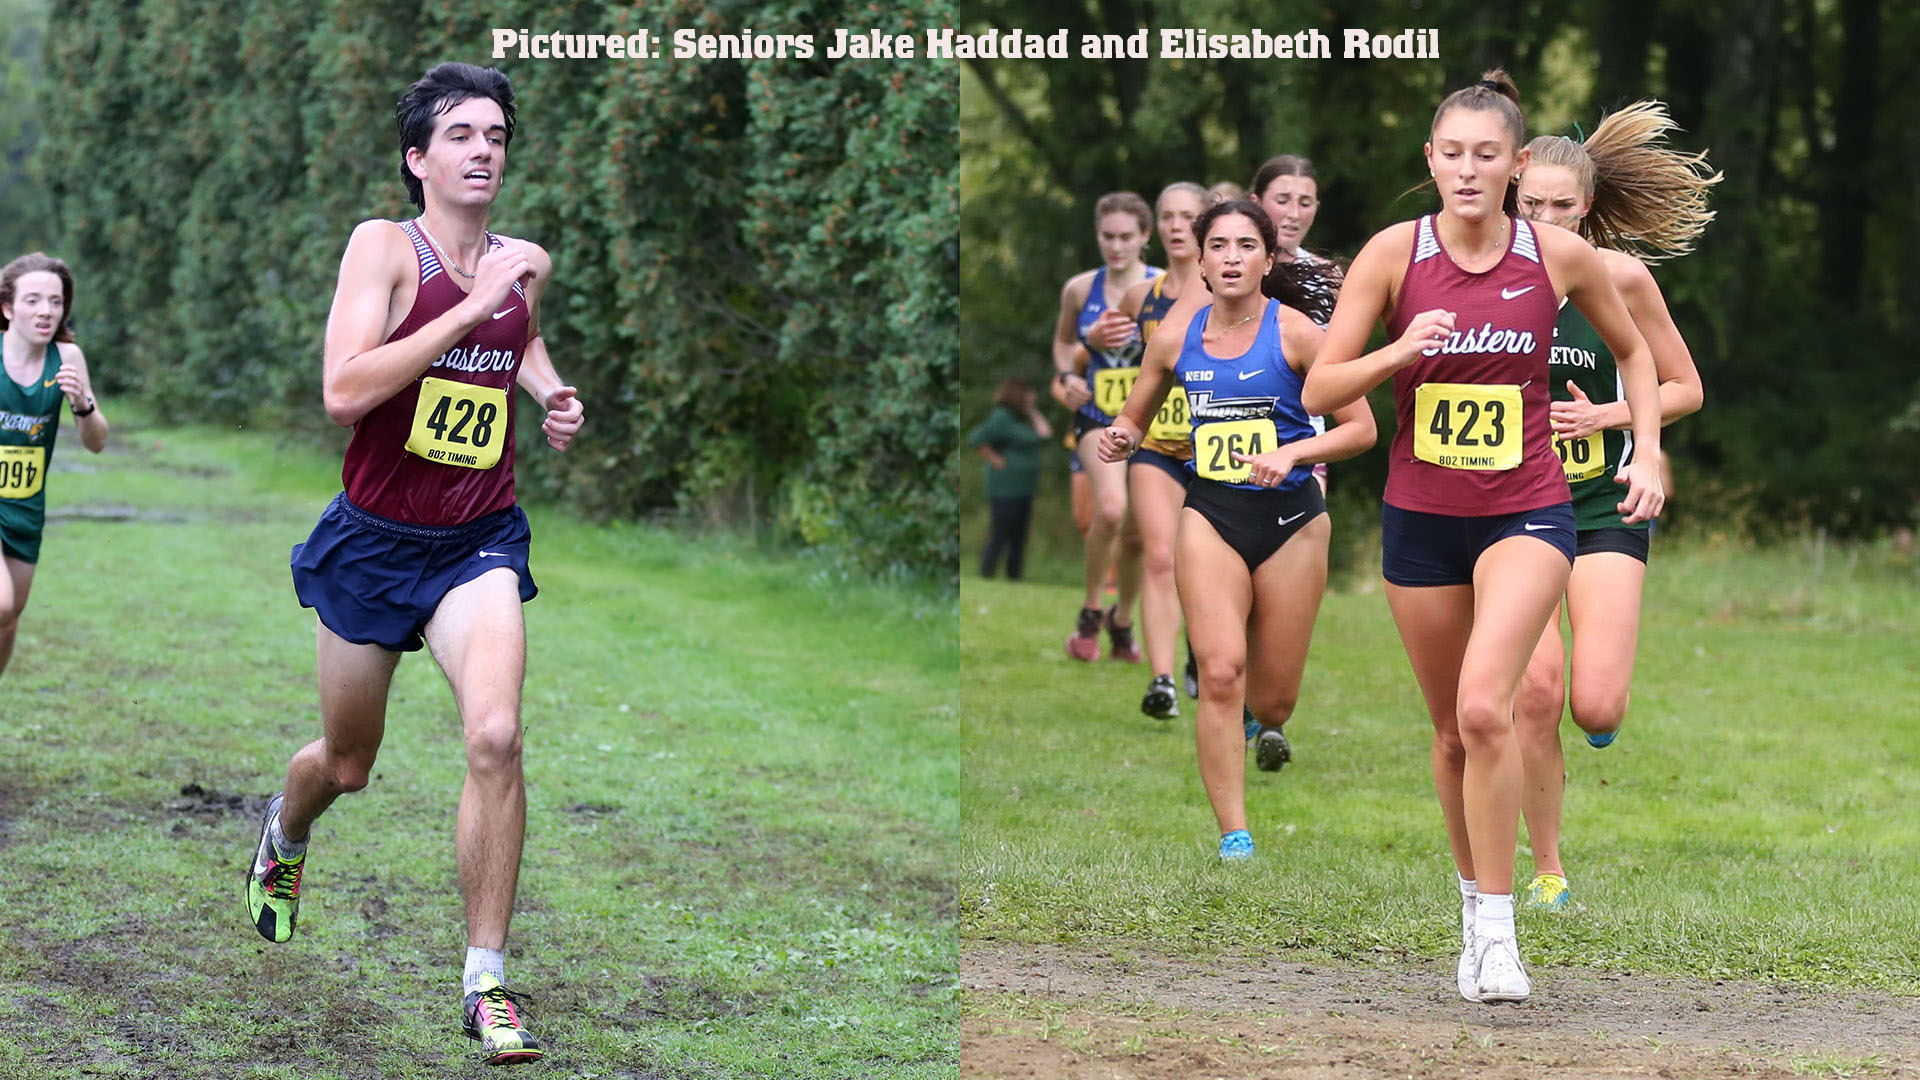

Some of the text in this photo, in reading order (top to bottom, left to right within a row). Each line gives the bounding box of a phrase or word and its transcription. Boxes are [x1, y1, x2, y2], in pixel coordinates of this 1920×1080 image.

[1548, 345, 1596, 371] ETON
[1103, 376, 1138, 403] 71
[426, 395, 498, 448] 428
[1158, 396, 1192, 425] 68
[1429, 399, 1506, 448] 423
[427, 448, 478, 466] 802 TIMING
[1439, 455, 1495, 467] 802 TIMING
[0, 460, 37, 489] 460
[1566, 471, 1585, 481] ING
